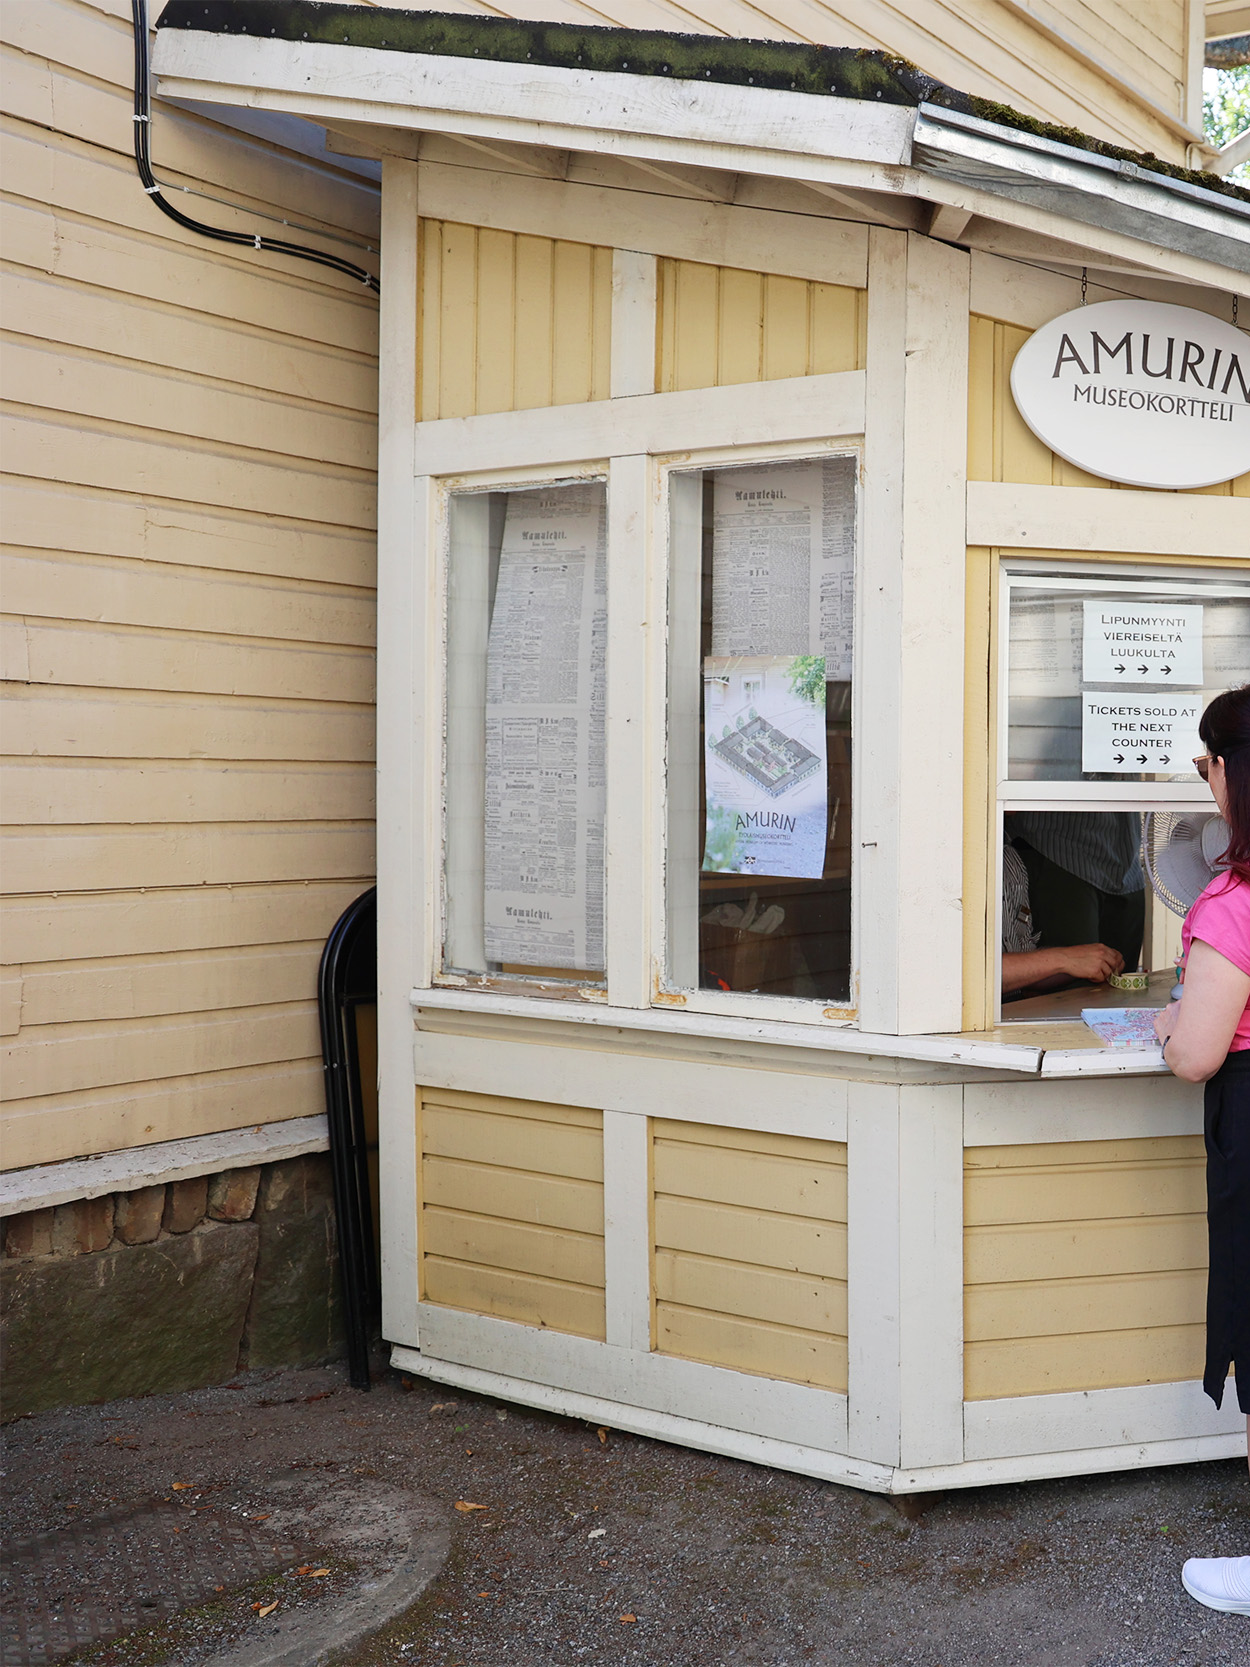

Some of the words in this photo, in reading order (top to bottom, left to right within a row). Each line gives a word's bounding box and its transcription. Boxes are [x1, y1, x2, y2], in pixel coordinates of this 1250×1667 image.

[1073, 383, 1234, 422] MUSEOKORTTELI
[1101, 614, 1187, 627] LIPUNMYYNTI
[1103, 632, 1183, 643] VIEREISELTÄ
[1111, 648, 1176, 659] LUUKULTA
[1088, 704, 1142, 716] TICKETS
[1144, 708, 1178, 717] SOLD
[1180, 709, 1197, 717] AT
[1111, 722, 1137, 732] THE
[1140, 723, 1173, 732] NEXT
[1111, 738, 1173, 748] COUNTER
[735, 811, 796, 832] AMURIN
